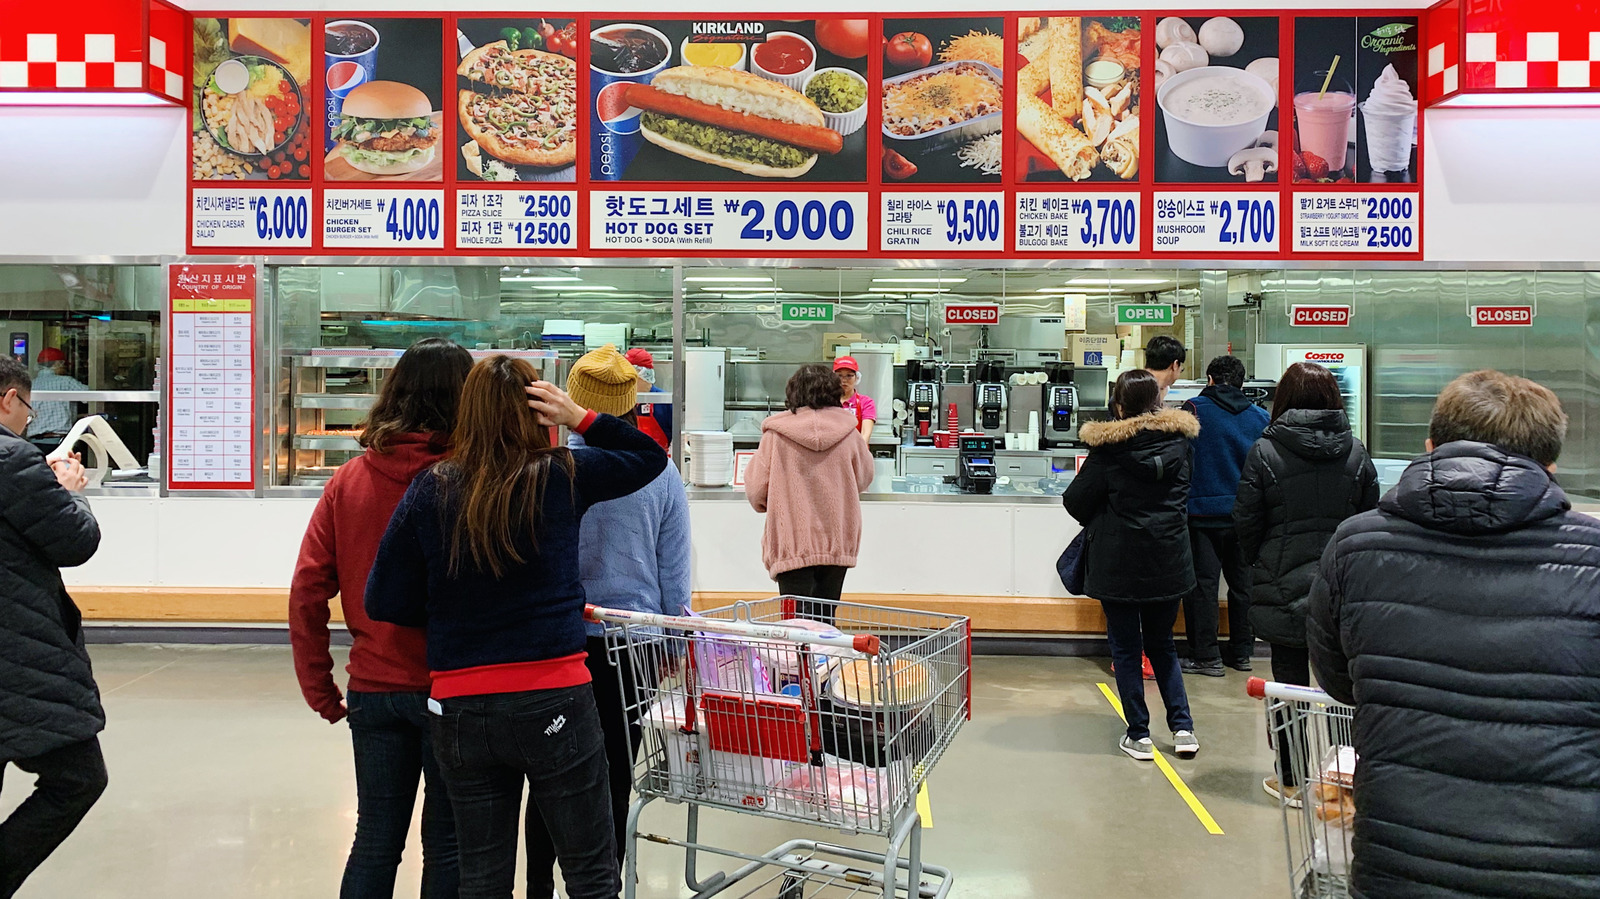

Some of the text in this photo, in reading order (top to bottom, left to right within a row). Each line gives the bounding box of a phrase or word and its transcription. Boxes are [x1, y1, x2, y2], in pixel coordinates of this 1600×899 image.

[692, 22, 765, 34] KIRKLAND
[692, 34, 764, 43] Signature
[1361, 35, 1405, 52] Organic
[326, 97, 338, 128] pepsi
[598, 133, 614, 175] pepsi
[196, 196, 245, 211] 치킨시저샐러드
[326, 198, 372, 210] 치킨버거세트
[461, 194, 503, 207] 피자 1조각
[605, 195, 715, 217] 핫도그세트
[887, 199, 933, 211] 칠리 라이스
[1020, 198, 1069, 211] 치킨 베이크
[1300, 198, 1359, 210] 딸기 요거트 스무디
[1157, 199, 1205, 218] 양송이스프
[887, 212, 912, 223] 그라탕
[196, 220, 245, 228] CHICKEN CAESAR
[461, 221, 503, 234] 피자 1판
[605, 222, 714, 235] HOT DOG SET
[1157, 225, 1206, 233] MUSHROOM
[196, 230, 215, 238] SALAD
[1019, 224, 1068, 238] 불고기 베이크
[1313, 226, 1330, 238] 소프트
[1331, 226, 1360, 238] 아이스크림
[1157, 236, 1180, 245] SOUP
[789, 306, 826, 318] OPEN
[947, 309, 996, 320] CLOSED
[1125, 308, 1164, 319] OPEN
[1296, 310, 1347, 322] CLOSED
[1478, 310, 1529, 321] CLOSED
